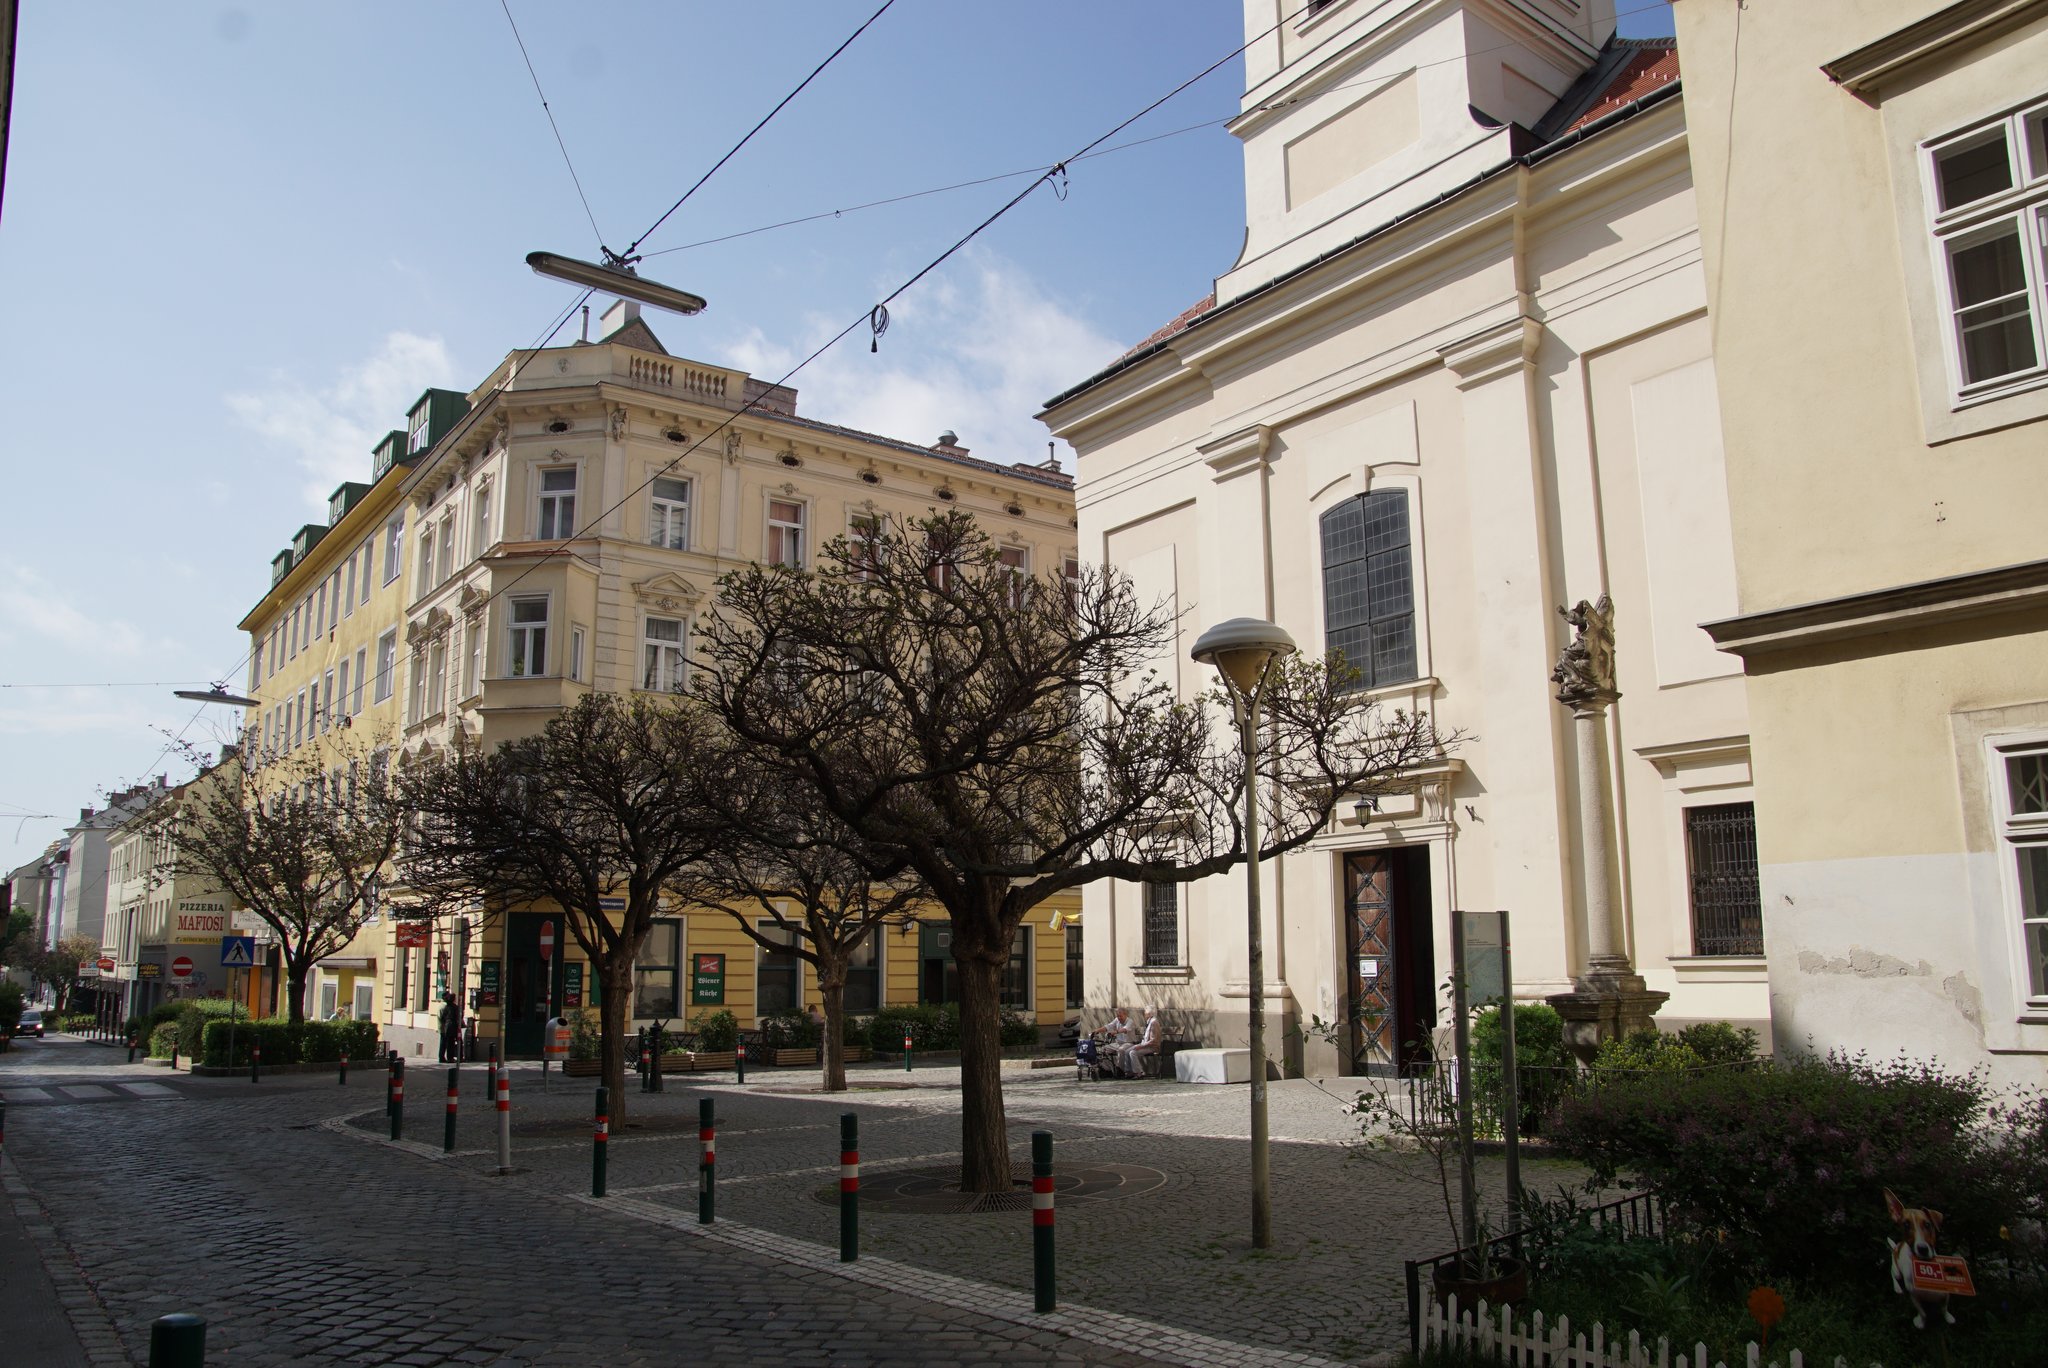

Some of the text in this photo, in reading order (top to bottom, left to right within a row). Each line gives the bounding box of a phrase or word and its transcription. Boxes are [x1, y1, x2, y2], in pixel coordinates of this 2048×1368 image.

[179, 903, 224, 912] PIZZERIA
[177, 915, 224, 931] MAFIOSI
[699, 989, 718, 997] Küche
